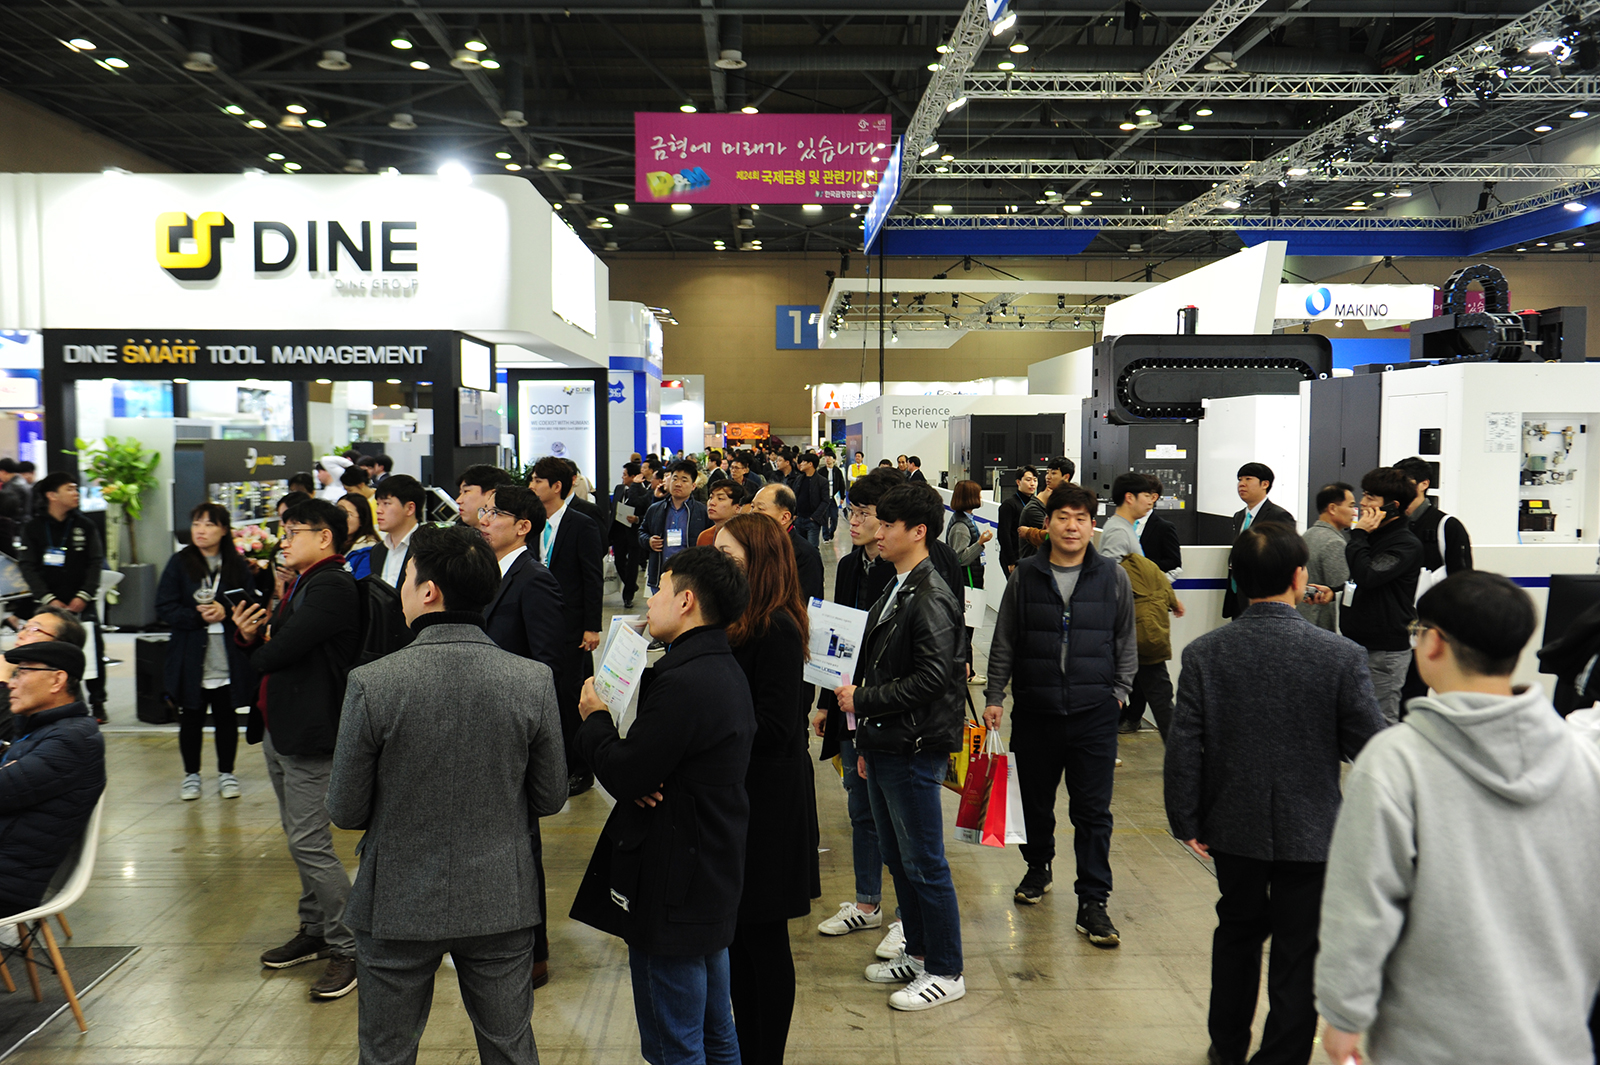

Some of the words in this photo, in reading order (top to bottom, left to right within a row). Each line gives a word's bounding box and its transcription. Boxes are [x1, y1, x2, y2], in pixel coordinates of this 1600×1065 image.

[650, 134, 711, 160] 금형에
[722, 141, 787, 156] 미래가
[797, 135, 880, 165] 있습니다
[646, 166, 711, 198] D&M
[736, 170, 760, 181] 제24회
[761, 169, 806, 185] 국제금형
[809, 170, 820, 185] 및
[254, 220, 418, 272] DINE
[1334, 303, 1389, 317] MAKINO
[789, 310, 802, 344] 1
[63, 344, 118, 364] DINE
[122, 345, 201, 364] SMART
[206, 345, 265, 364] TOOL
[271, 345, 428, 364] MANAGEMENT
[530, 404, 570, 415] COBOT
[892, 405, 950, 417] Experience
[892, 419, 912, 430] The
[915, 419, 939, 430] New
[941, 419, 949, 430] T
